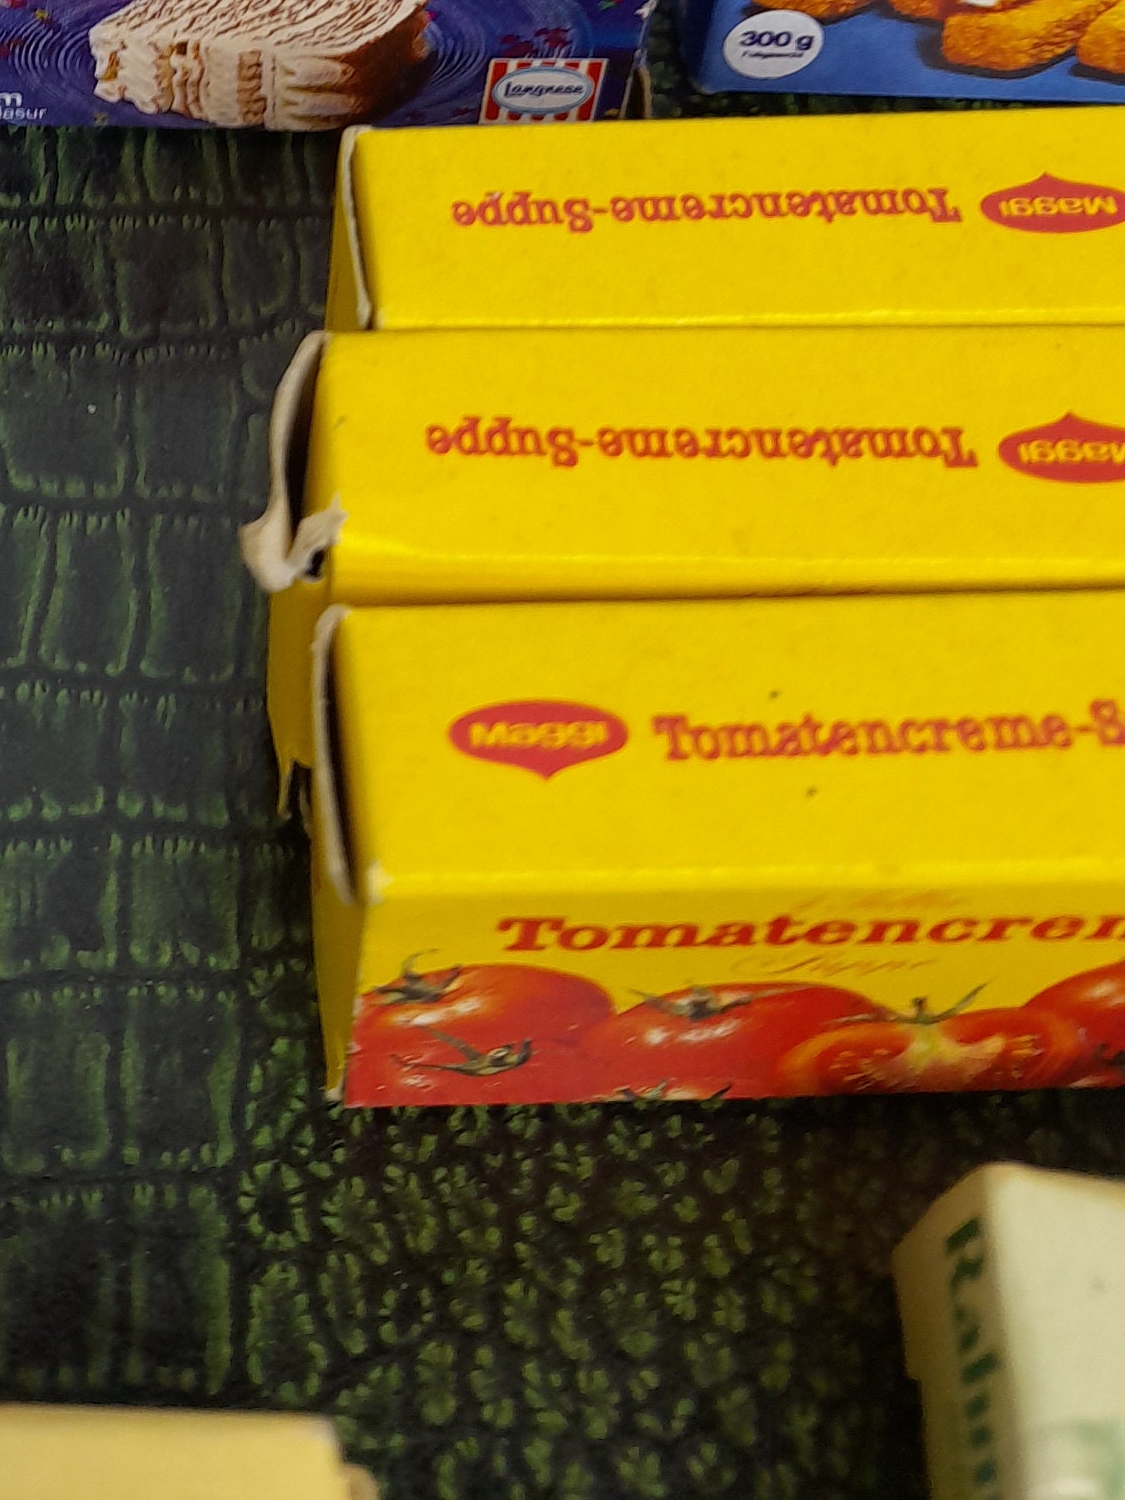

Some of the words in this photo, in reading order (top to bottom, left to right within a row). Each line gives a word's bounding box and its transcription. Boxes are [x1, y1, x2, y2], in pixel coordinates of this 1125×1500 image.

[738, 29, 793, 48] 300
[795, 34, 815, 52] g
[503, 81, 584, 98] Langnese
[452, 187, 963, 234] Tomatencreme-Suppe
[998, 195, 1119, 219] Maggi
[426, 415, 979, 468] Tomatencreme-Suppe
[468, 719, 608, 749] Maggi
